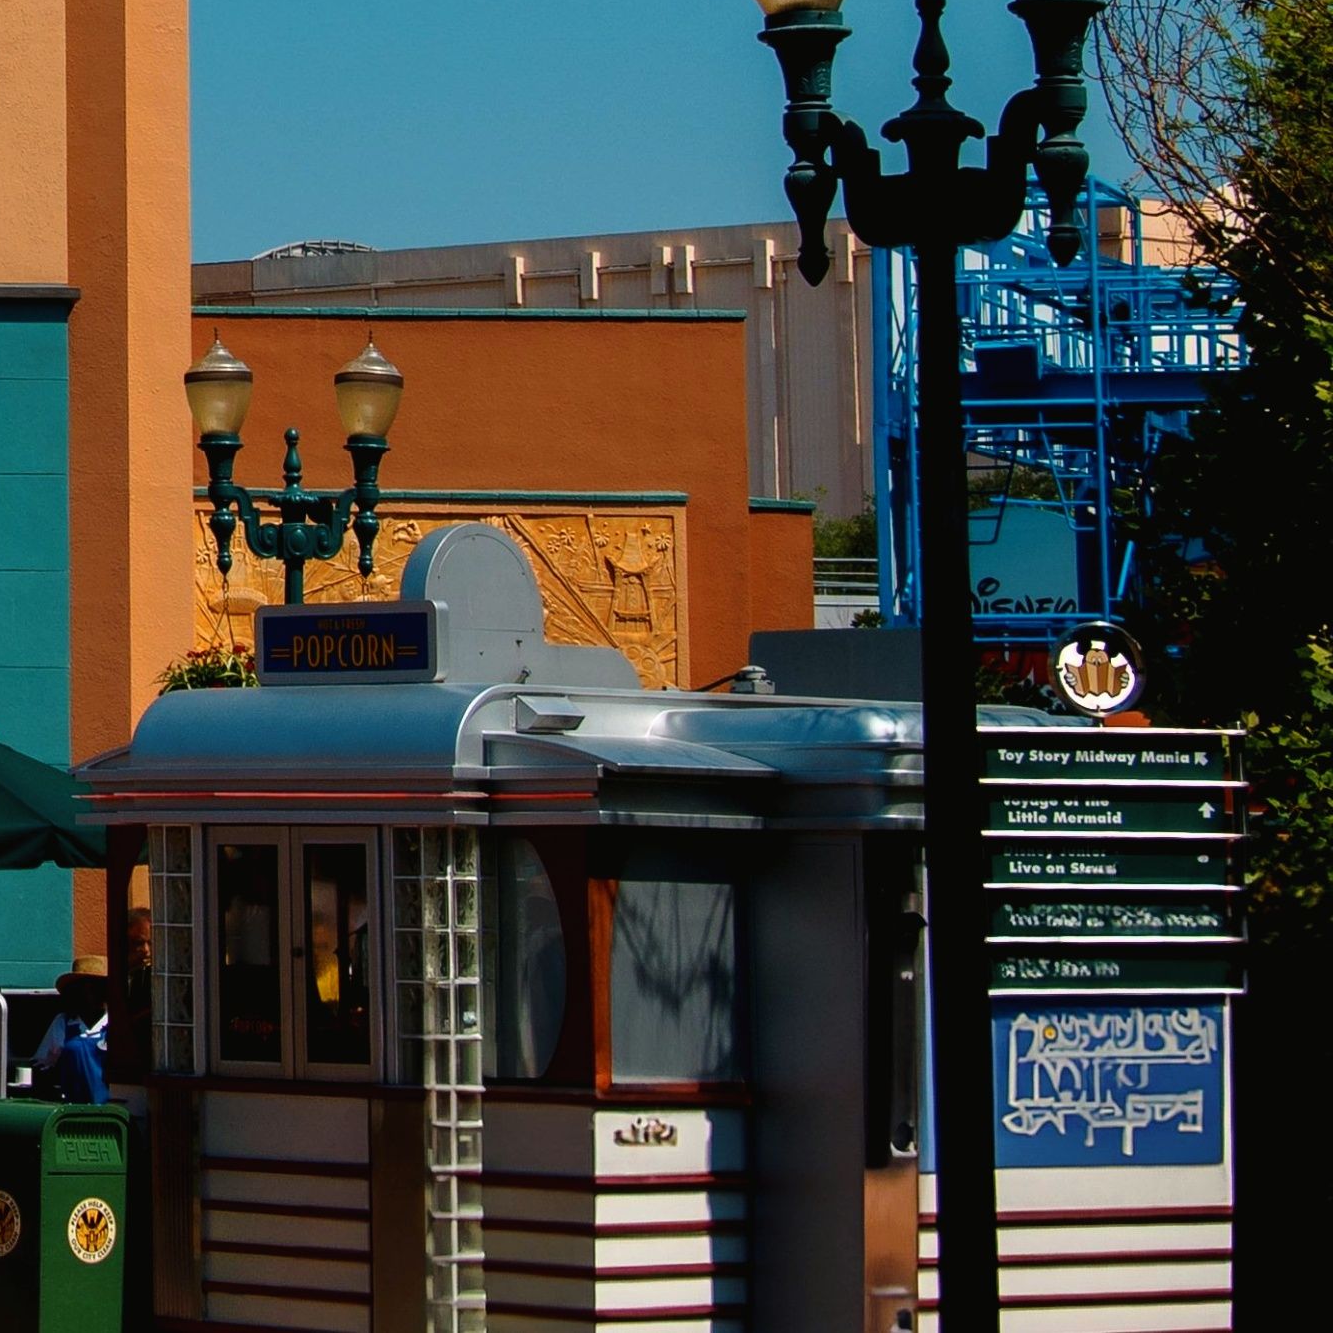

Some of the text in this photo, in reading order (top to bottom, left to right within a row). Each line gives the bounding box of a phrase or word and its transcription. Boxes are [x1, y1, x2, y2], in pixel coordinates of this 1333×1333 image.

[292, 633, 396, 668] POPCORN
[997, 749, 1191, 765] Toy Story Midway Mania
[1007, 811, 1123, 825] Little Mermaid
[1008, 861, 1042, 875] Live
[1046, 863, 1065, 875] on
[62, 1140, 111, 1163] PUSH
[71, 1200, 113, 1226] PLEASE HELP KEEP
[71, 1238, 82, 1254] OUR
[97, 1237, 113, 1258] CLEAN
